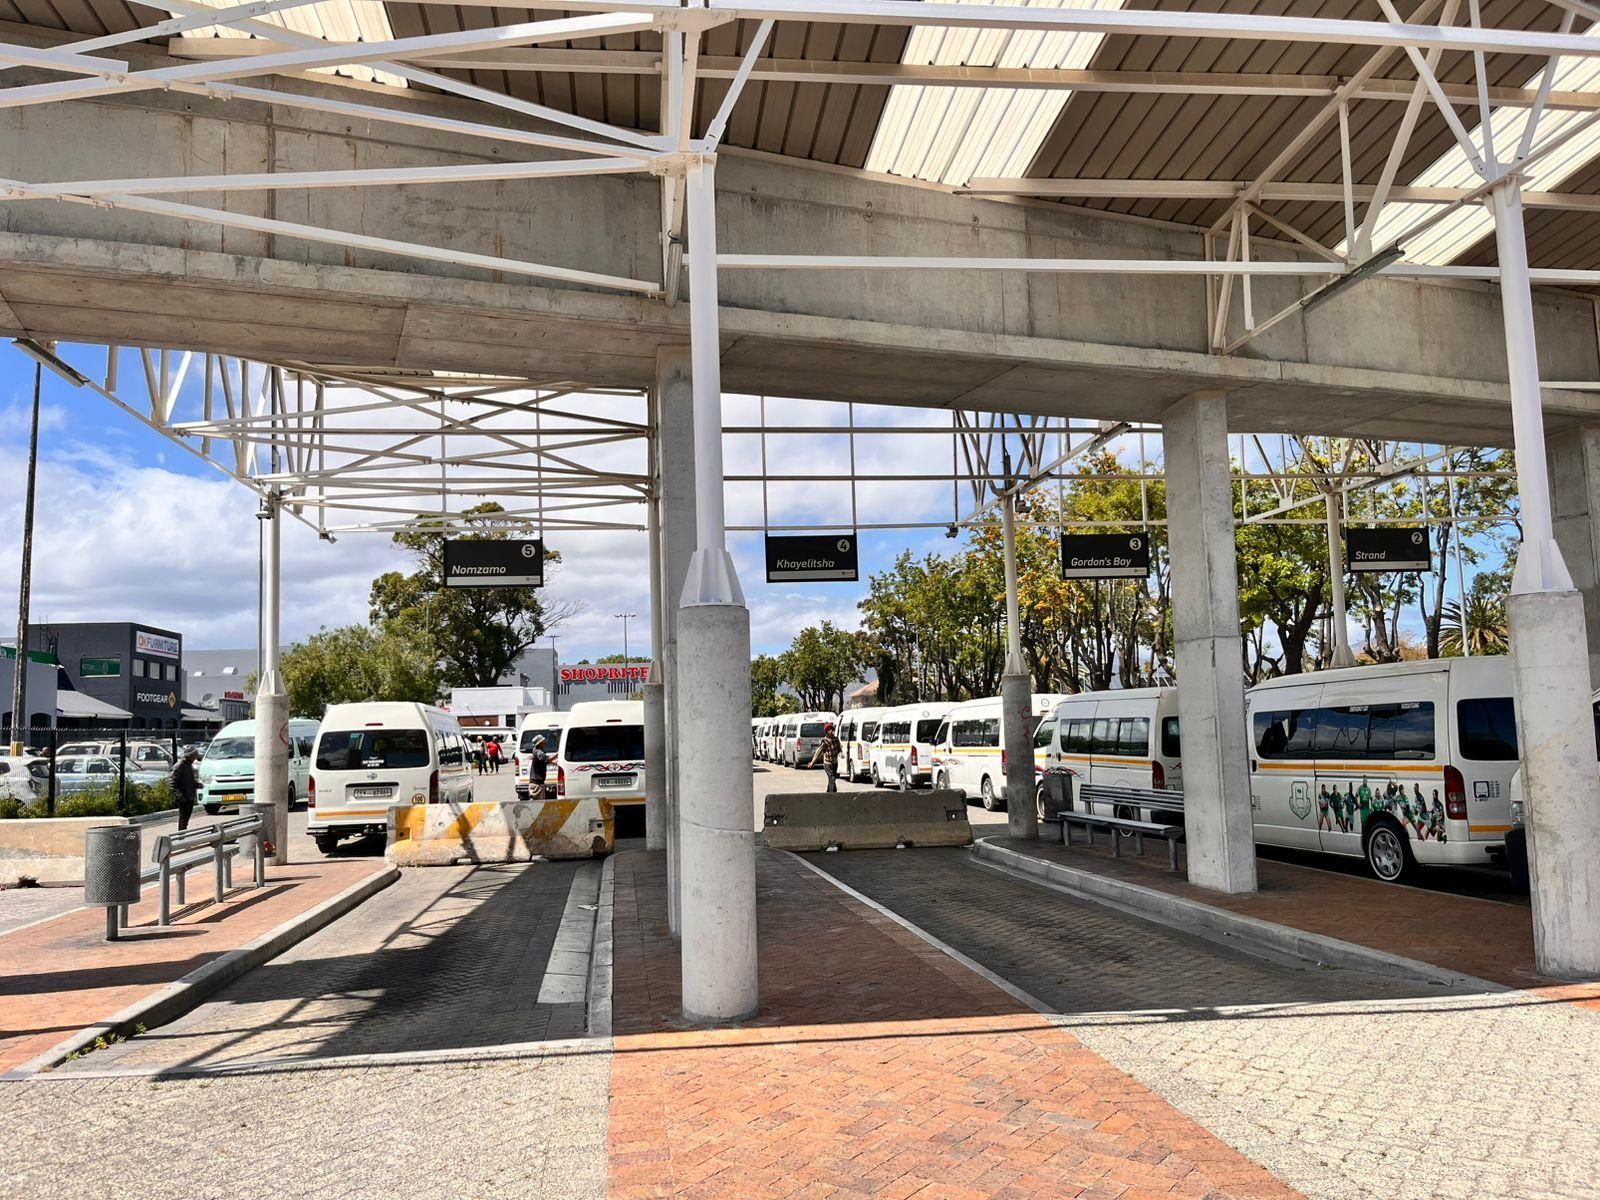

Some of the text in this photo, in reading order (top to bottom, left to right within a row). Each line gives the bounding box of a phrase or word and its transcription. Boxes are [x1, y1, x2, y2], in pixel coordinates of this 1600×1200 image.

[1355, 549, 1386, 561] Strand
[776, 558, 835, 570] Khayelitsha
[1071, 556, 1132, 568] Gordon's Bay
[451, 564, 507, 576] Nomzamo
[147, 636, 178, 653] FURNITURE
[560, 666, 649, 681] SHOPRITE
[136, 692, 168, 704] FOOTGEAR
